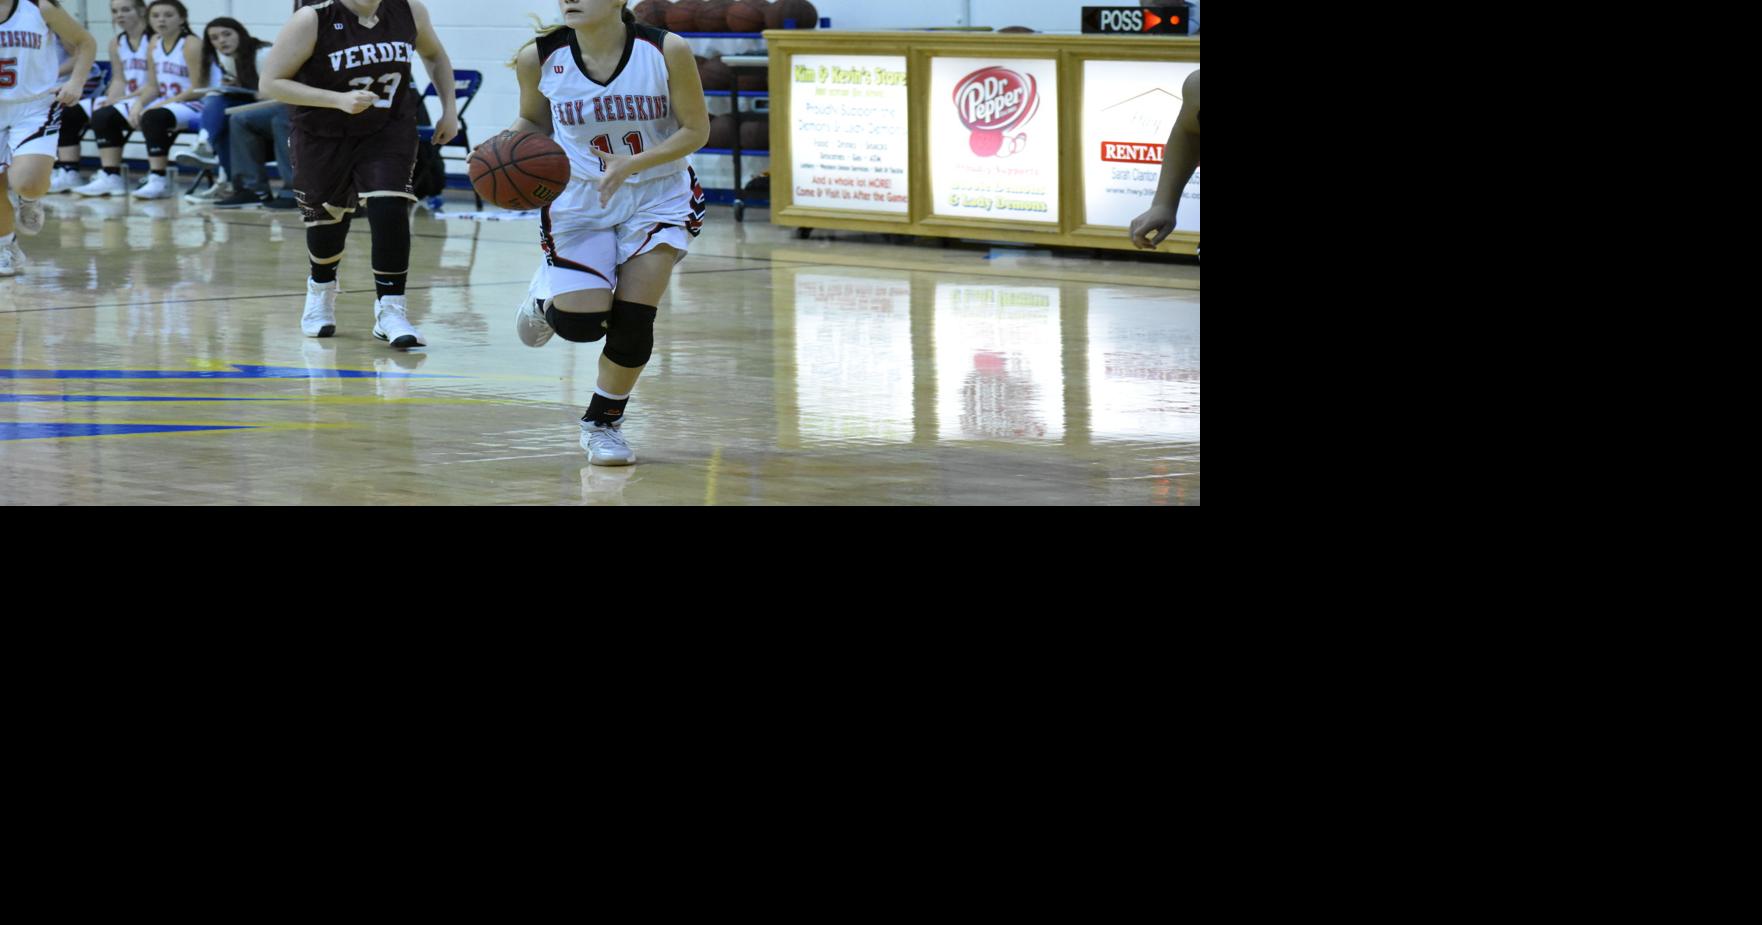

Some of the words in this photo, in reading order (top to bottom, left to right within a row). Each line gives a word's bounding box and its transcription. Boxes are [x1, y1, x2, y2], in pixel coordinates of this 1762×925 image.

[1101, 10, 1143, 31] POSS
[795, 65, 816, 83] Kim
[832, 65, 872, 85] Kevin's
[874, 67, 907, 86] Store
[984, 76, 1008, 100] Dr
[592, 95, 667, 122] REDSKINS
[962, 81, 1023, 123] Pepper
